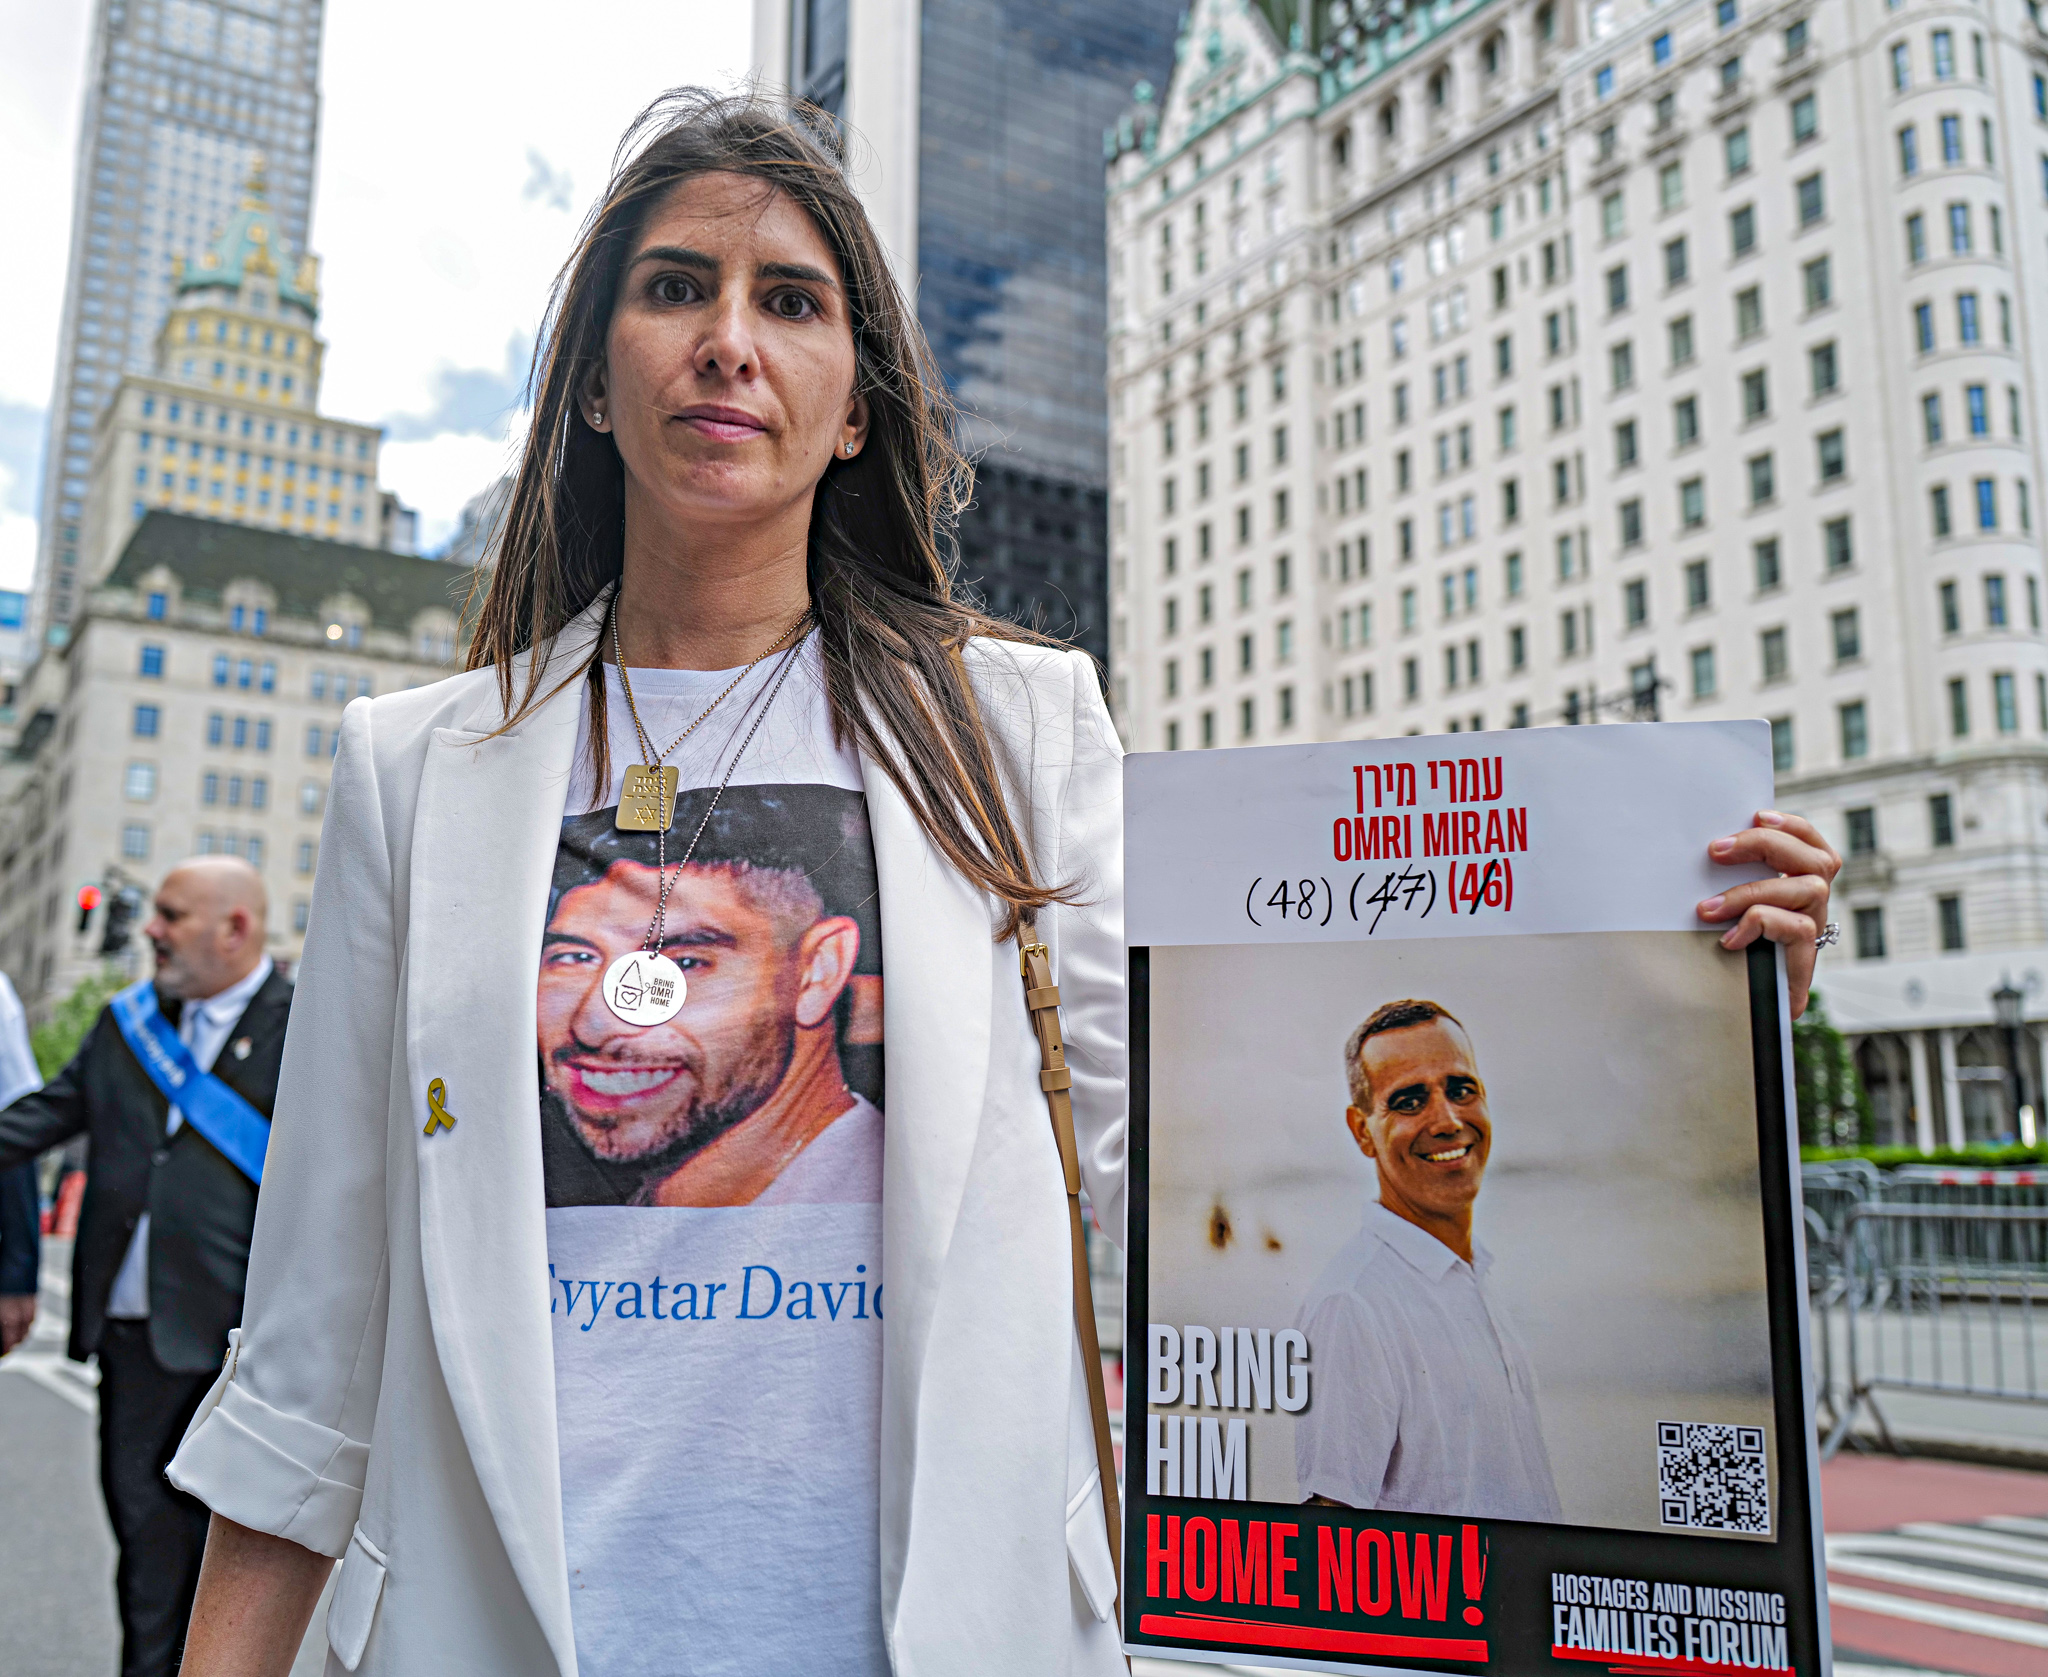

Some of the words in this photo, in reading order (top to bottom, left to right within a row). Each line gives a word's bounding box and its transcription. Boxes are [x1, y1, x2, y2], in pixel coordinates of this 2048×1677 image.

[1353, 762, 1417, 814] מירן
[1427, 756, 1503, 803] עמרי
[1333, 814, 1412, 862] OMRI
[1423, 807, 1528, 858] MIRAN
[1246, 876, 1333, 927] (48)
[1448, 858, 1513, 915] (46)
[650, 986, 674, 999] OMRI
[650, 997, 671, 1007] HOME
[653, 977, 675, 989] BRING
[1147, 1323, 1309, 1412] BRING
[1146, 1413, 1248, 1501] HIM
[1146, 1513, 1300, 1609] HOME
[1316, 1523, 1489, 1626] NOW!
[1551, 1572, 1649, 1611] HOSTAGES
[1652, 1582, 1692, 1615] AND
[1695, 1586, 1785, 1625] MISSING
[1553, 1603, 1678, 1660] FAMILIES
[1683, 1616, 1789, 1672] FORUM
